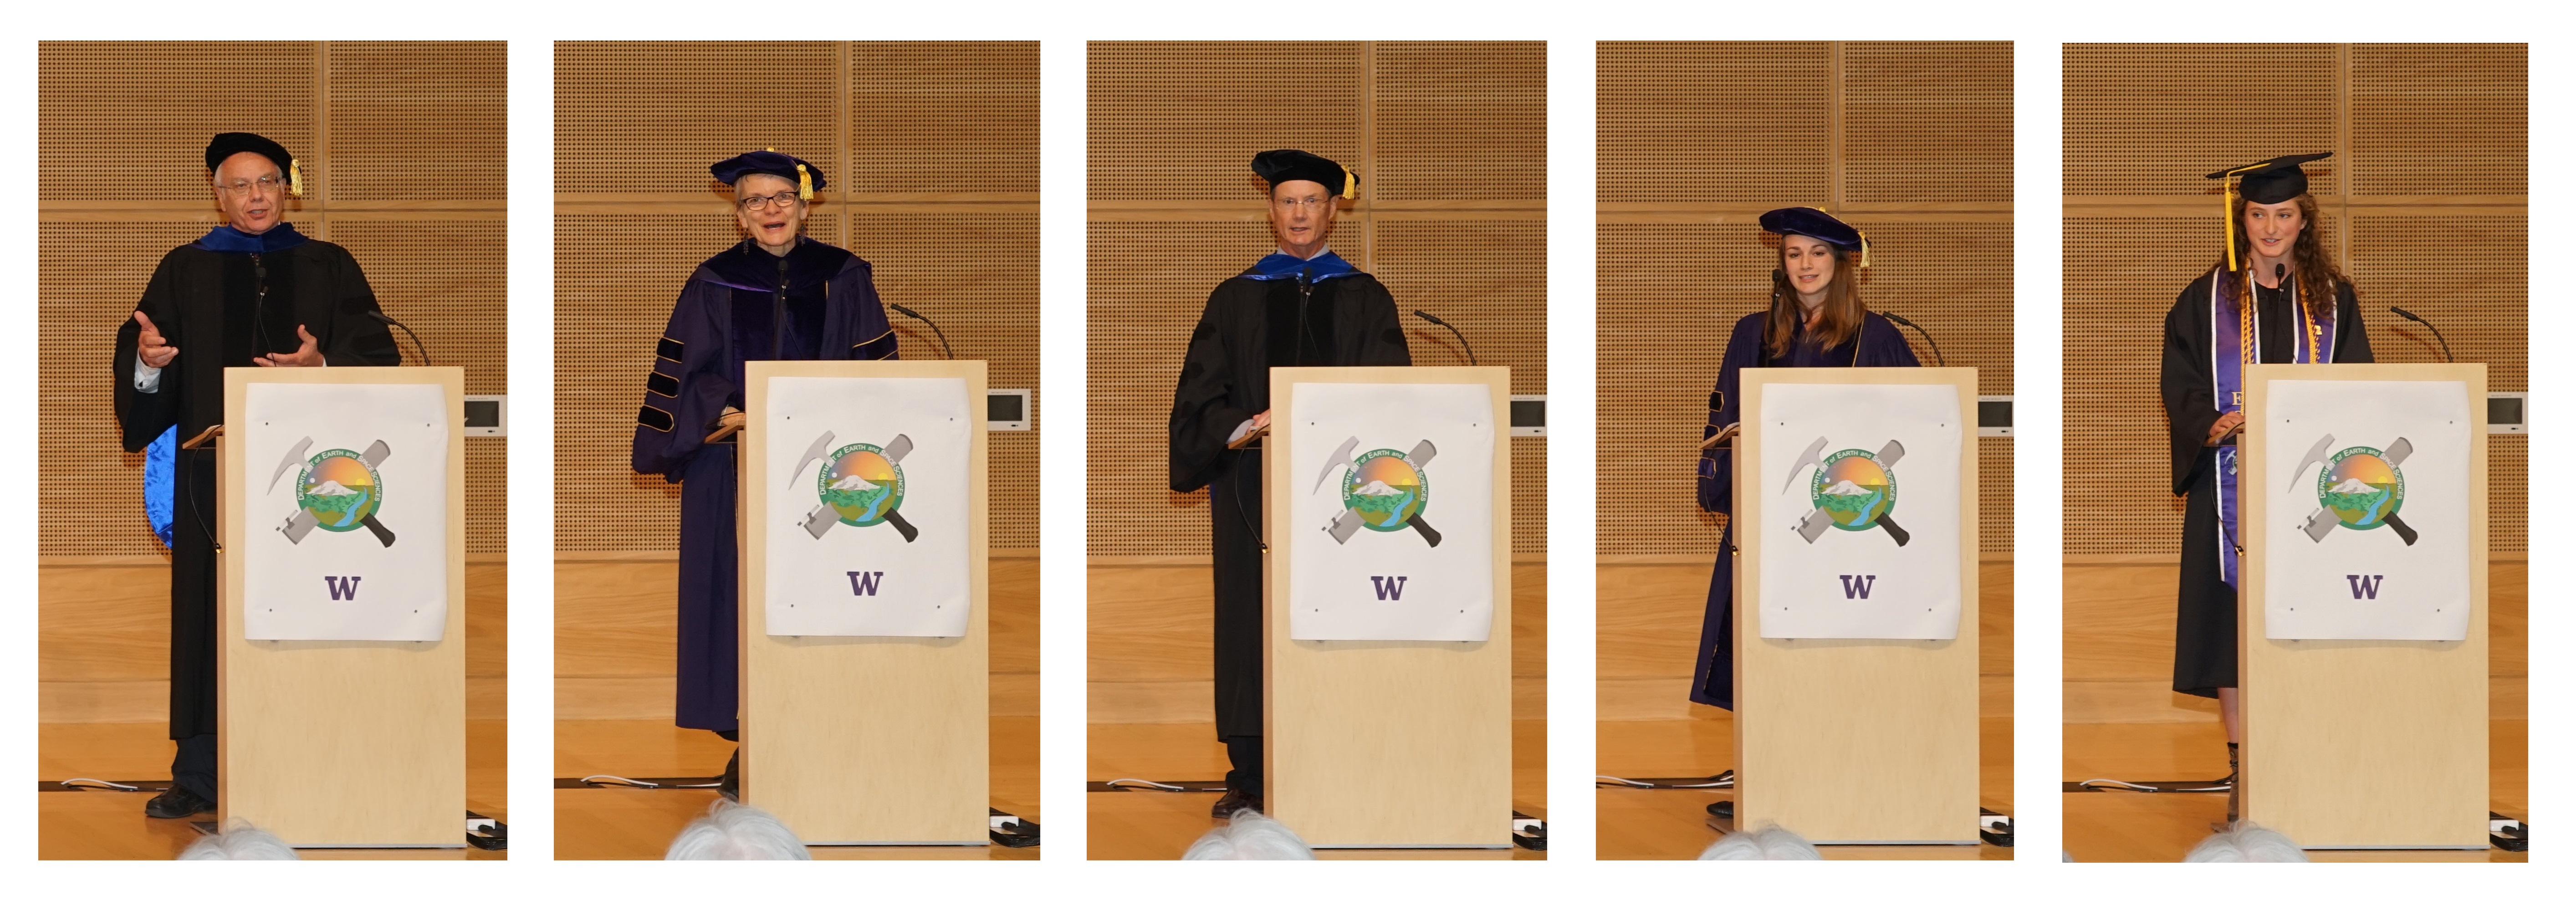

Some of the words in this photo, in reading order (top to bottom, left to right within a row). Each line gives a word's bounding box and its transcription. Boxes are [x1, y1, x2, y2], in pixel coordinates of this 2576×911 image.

[298, 461, 315, 500] DEPARTMENT
[322, 450, 343, 459] EARTH
[357, 456, 373, 472] SPACE
[371, 471, 381, 502] SCIENCES
[820, 457, 836, 495] DEPARTMENT
[843, 445, 865, 453] EARTH
[879, 450, 896, 467] SPACE
[893, 466, 904, 496] SCIENCES
[1344, 461, 1360, 500] DEPARTMENT
[1367, 450, 1390, 459] EARTH
[1403, 455, 1420, 472] SPACE
[1417, 471, 1427, 502] SCIENCES
[1813, 461, 1830, 500] DEPARTMENT
[1836, 450, 1858, 459] EARTH
[1872, 455, 1889, 472] SPACE
[1886, 471, 1895, 501] SCIENCES
[2319, 459, 2336, 498] DEPARTMENT
[2343, 448, 2366, 456] EARTH
[2379, 453, 2396, 470] SPACE
[2393, 469, 2403, 500] SCIENCES
[325, 576, 361, 601] W
[847, 571, 884, 596] W
[1370, 576, 1407, 601] W
[1840, 575, 1876, 599] W
[2346, 574, 2383, 599] W
